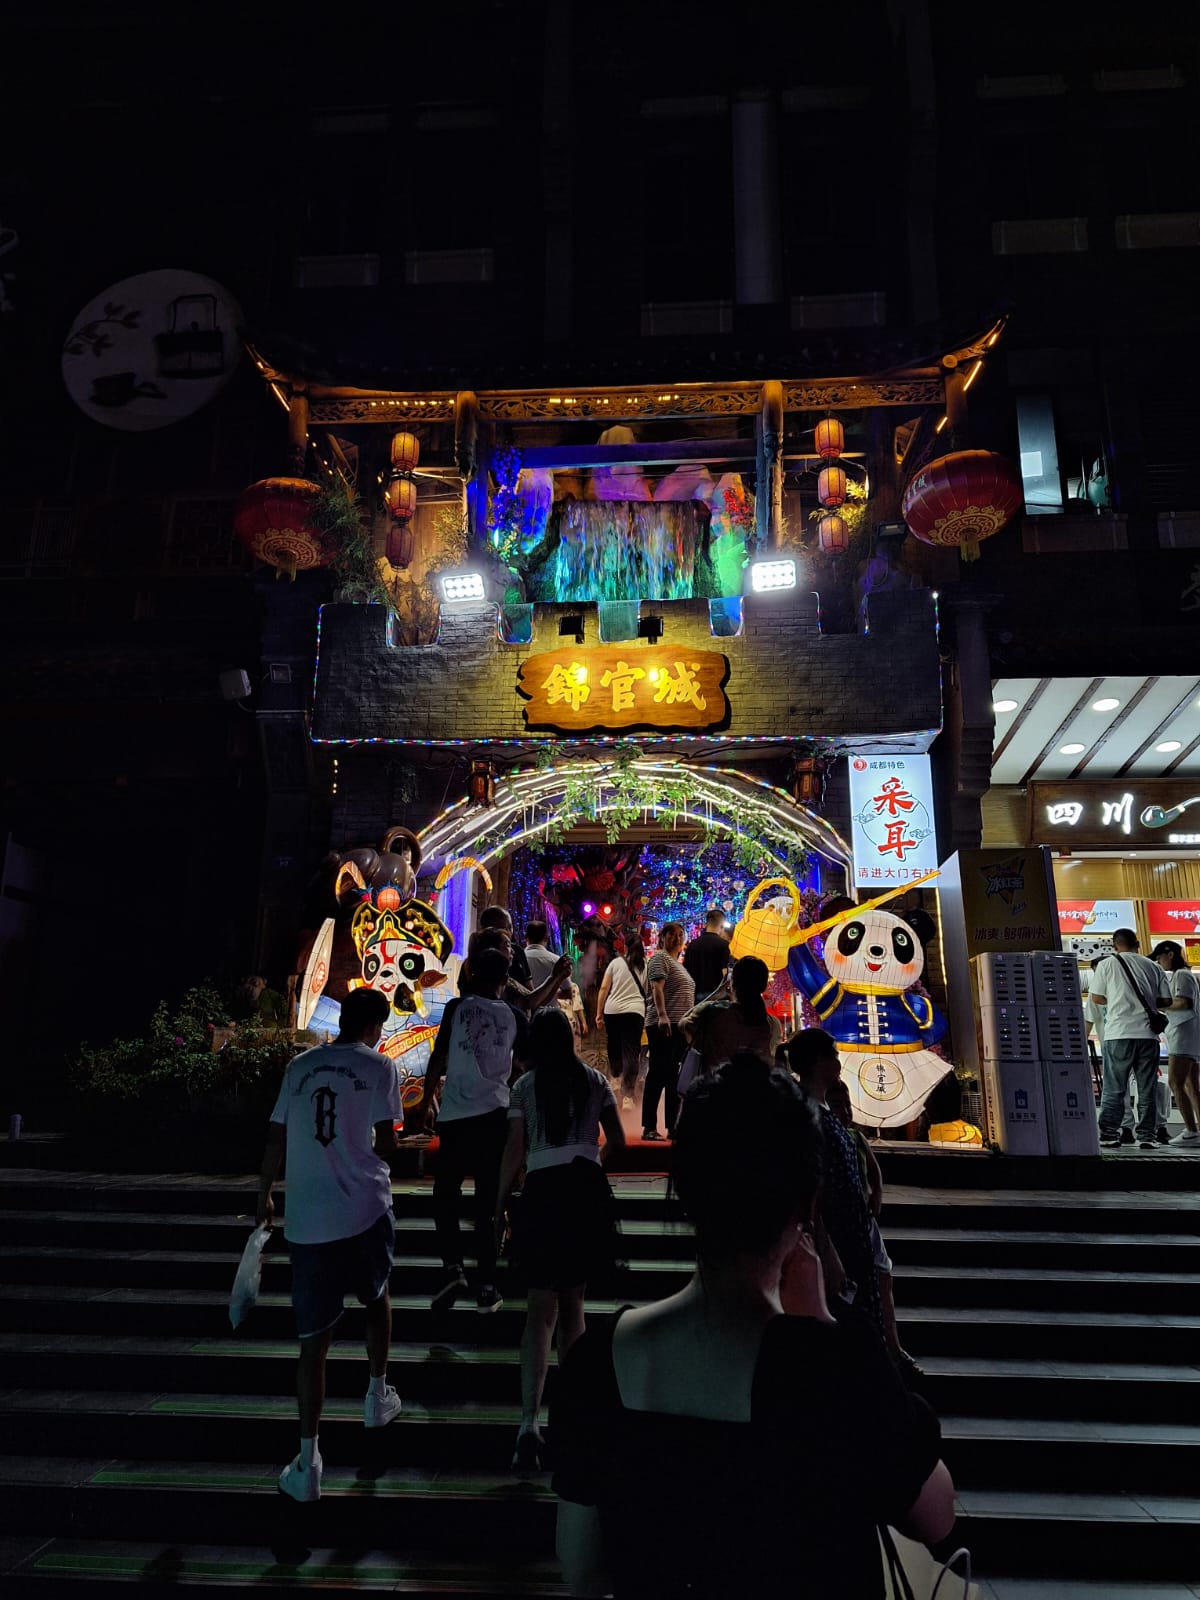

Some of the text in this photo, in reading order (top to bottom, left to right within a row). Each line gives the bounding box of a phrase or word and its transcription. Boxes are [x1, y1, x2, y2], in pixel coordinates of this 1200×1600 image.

[869, 760, 905, 769] 成都特色
[873, 776, 917, 860] 采耳
[1046, 793, 1134, 834] 四川
